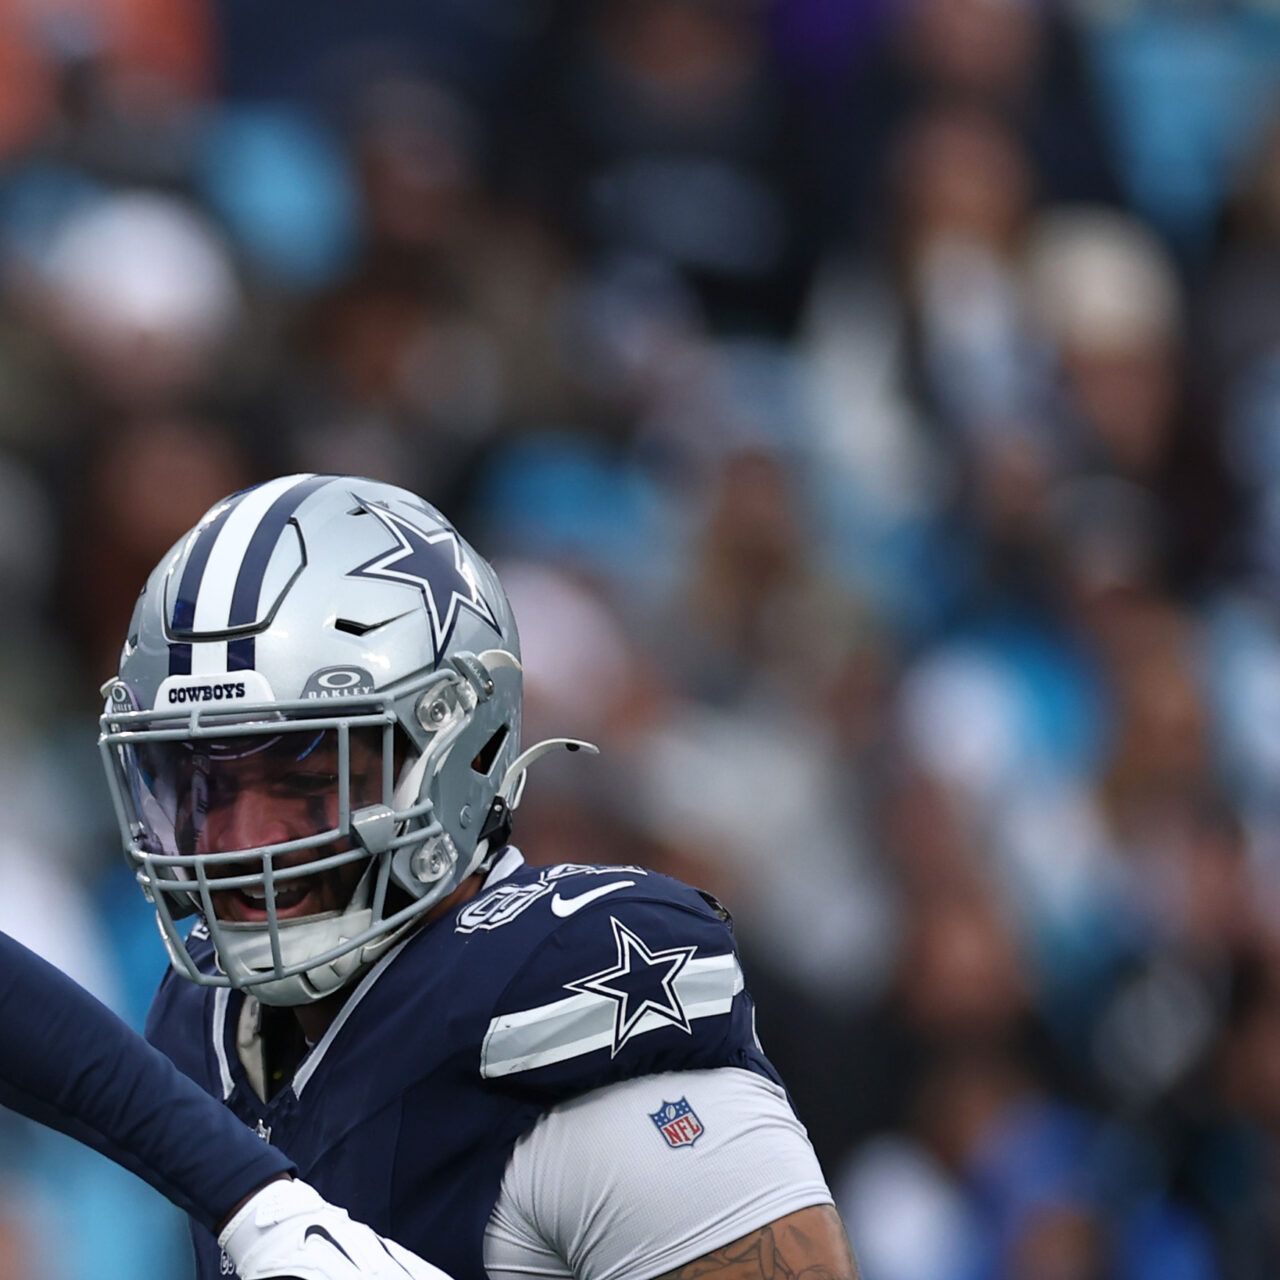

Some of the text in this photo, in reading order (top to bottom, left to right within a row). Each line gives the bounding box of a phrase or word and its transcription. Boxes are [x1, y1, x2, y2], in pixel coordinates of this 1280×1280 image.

[168, 682, 246, 704] COWBOYS
[308, 686, 370, 699] OAKLEY
[662, 1115, 701, 1145] NFL
